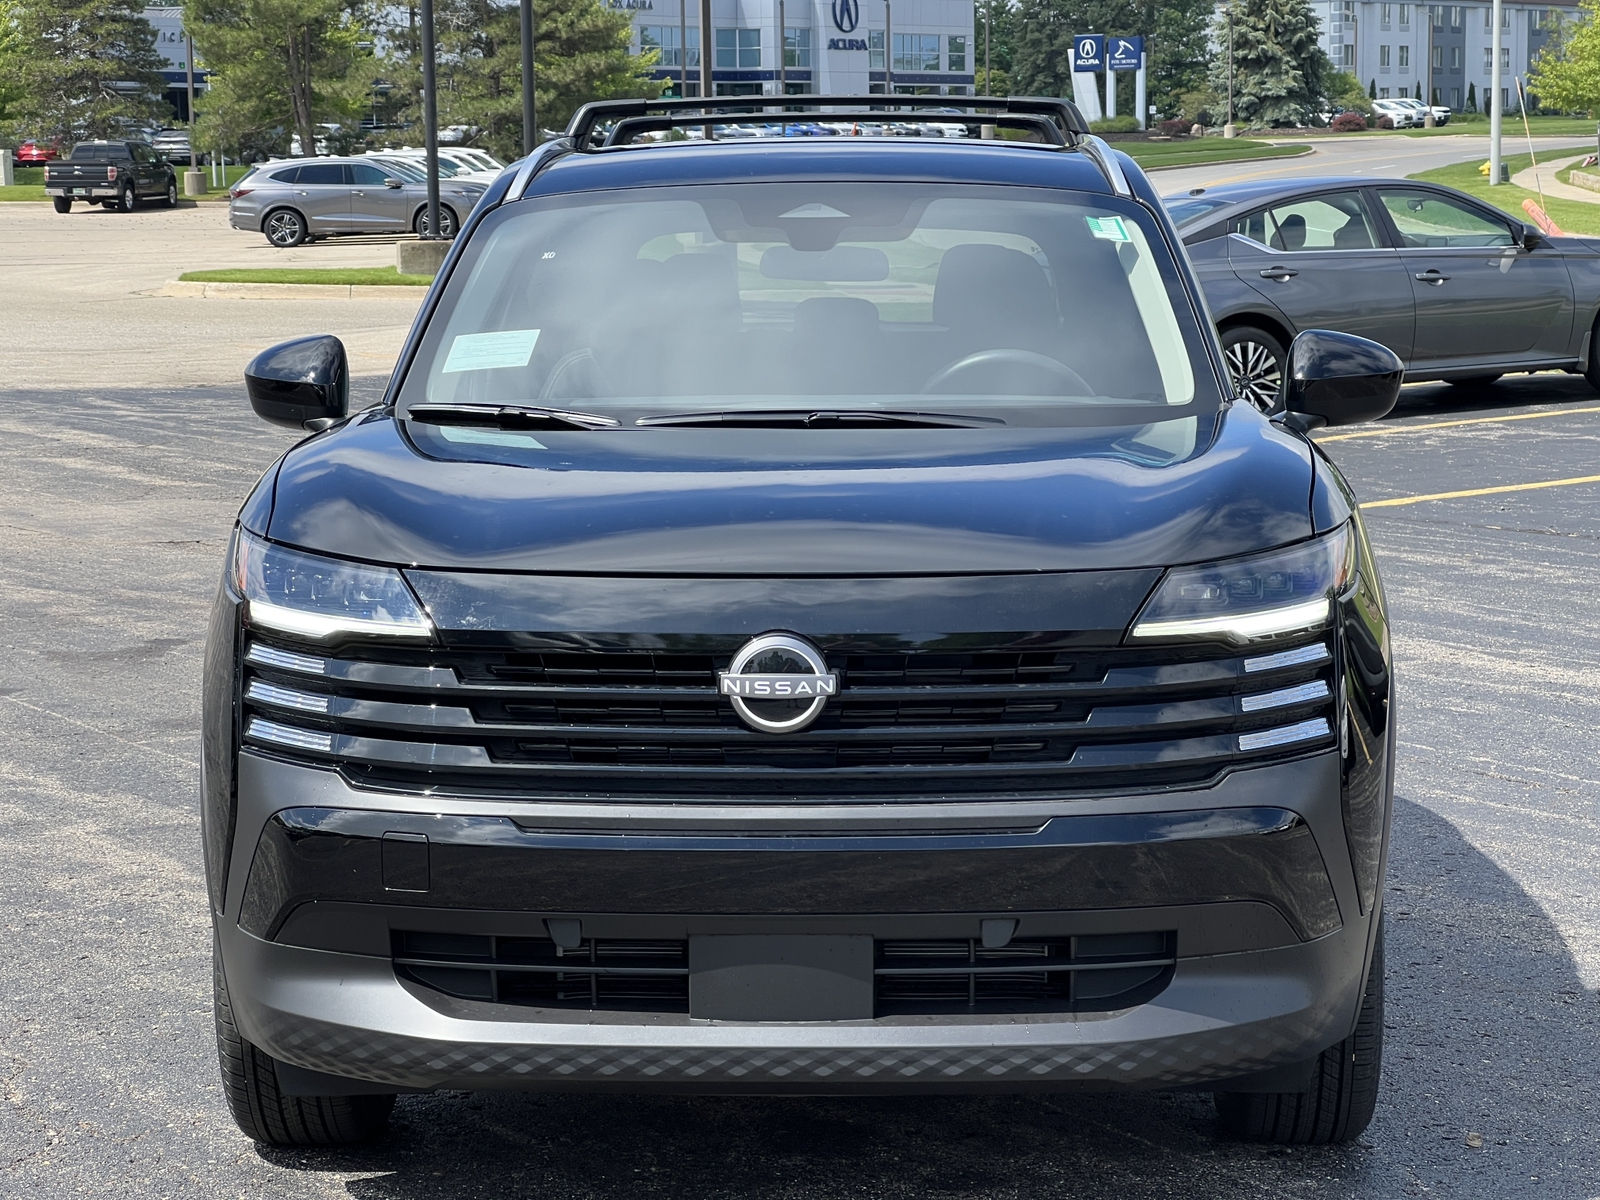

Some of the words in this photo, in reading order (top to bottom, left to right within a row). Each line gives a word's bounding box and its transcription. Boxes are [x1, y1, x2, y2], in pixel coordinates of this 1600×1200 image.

[610, 0, 623, 8] OX
[626, 0, 653, 10] ACURA
[828, 38, 868, 50] ACURA
[723, 678, 833, 695] NISSAN
